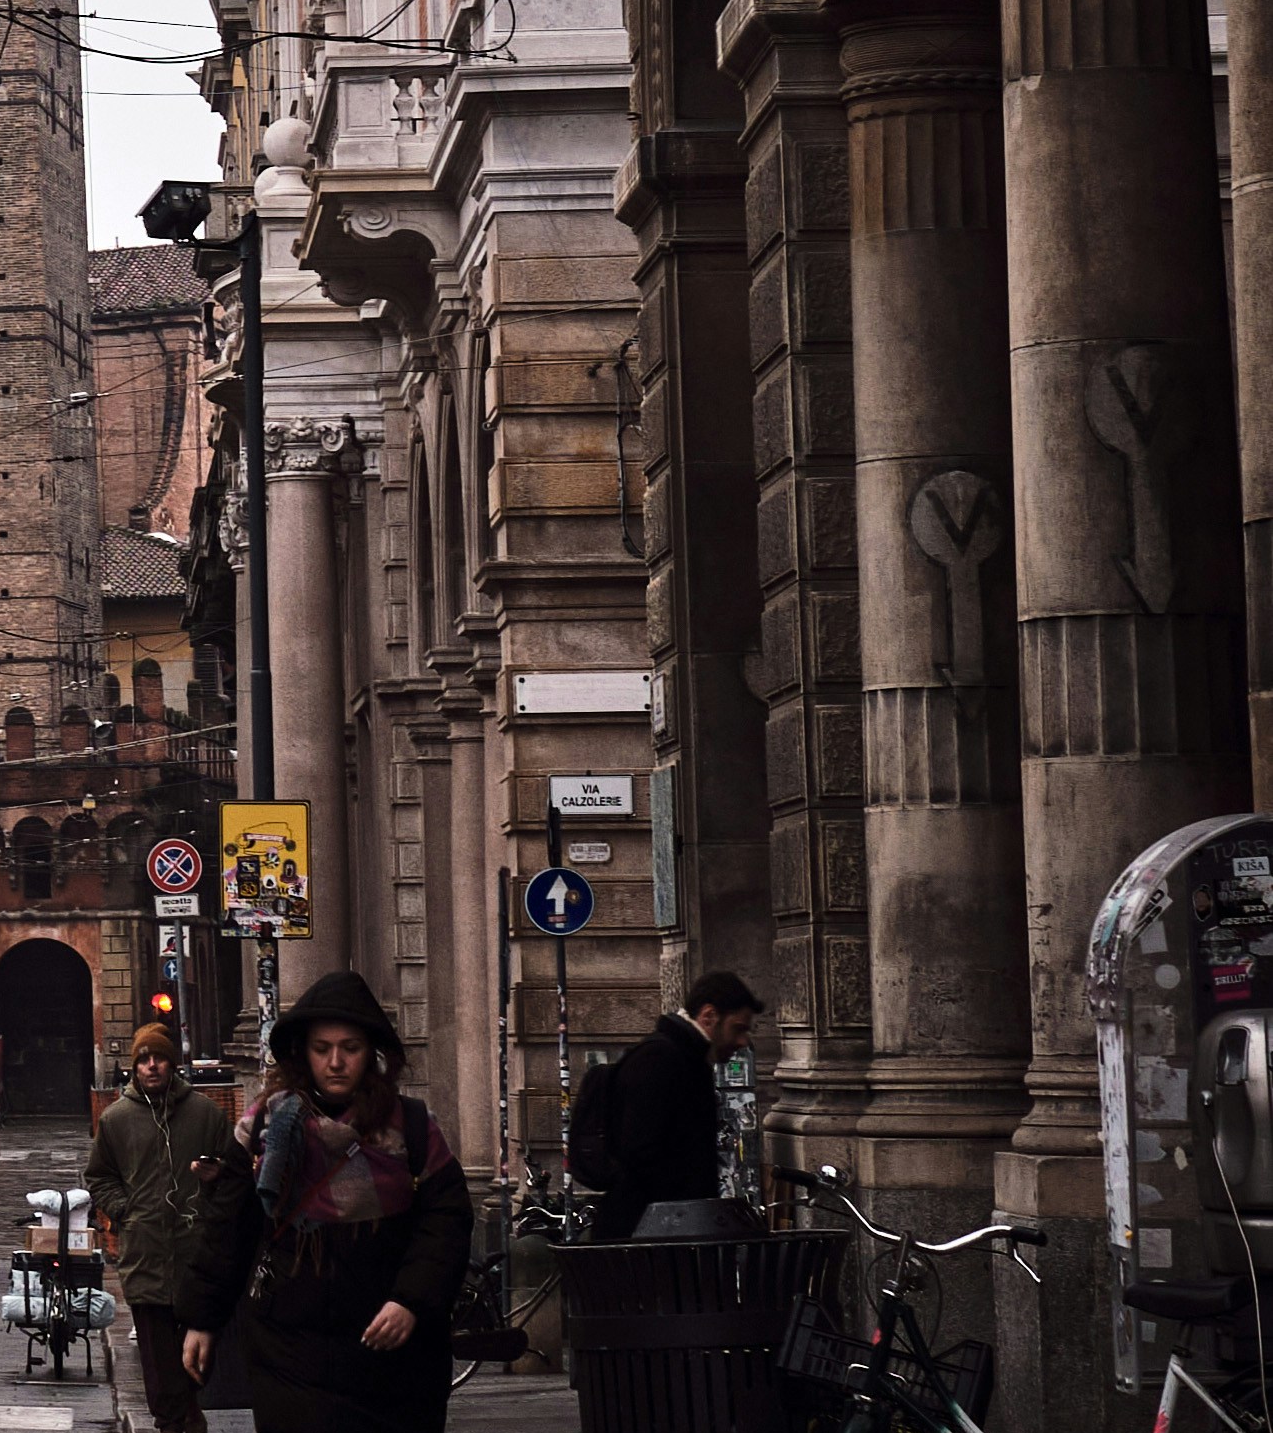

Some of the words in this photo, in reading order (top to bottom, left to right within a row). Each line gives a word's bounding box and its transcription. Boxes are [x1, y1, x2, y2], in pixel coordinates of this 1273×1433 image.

[582, 784, 600, 794] VIA
[561, 796, 622, 806] CALZOLERIE
[1237, 859, 1264, 872] KIŠA
